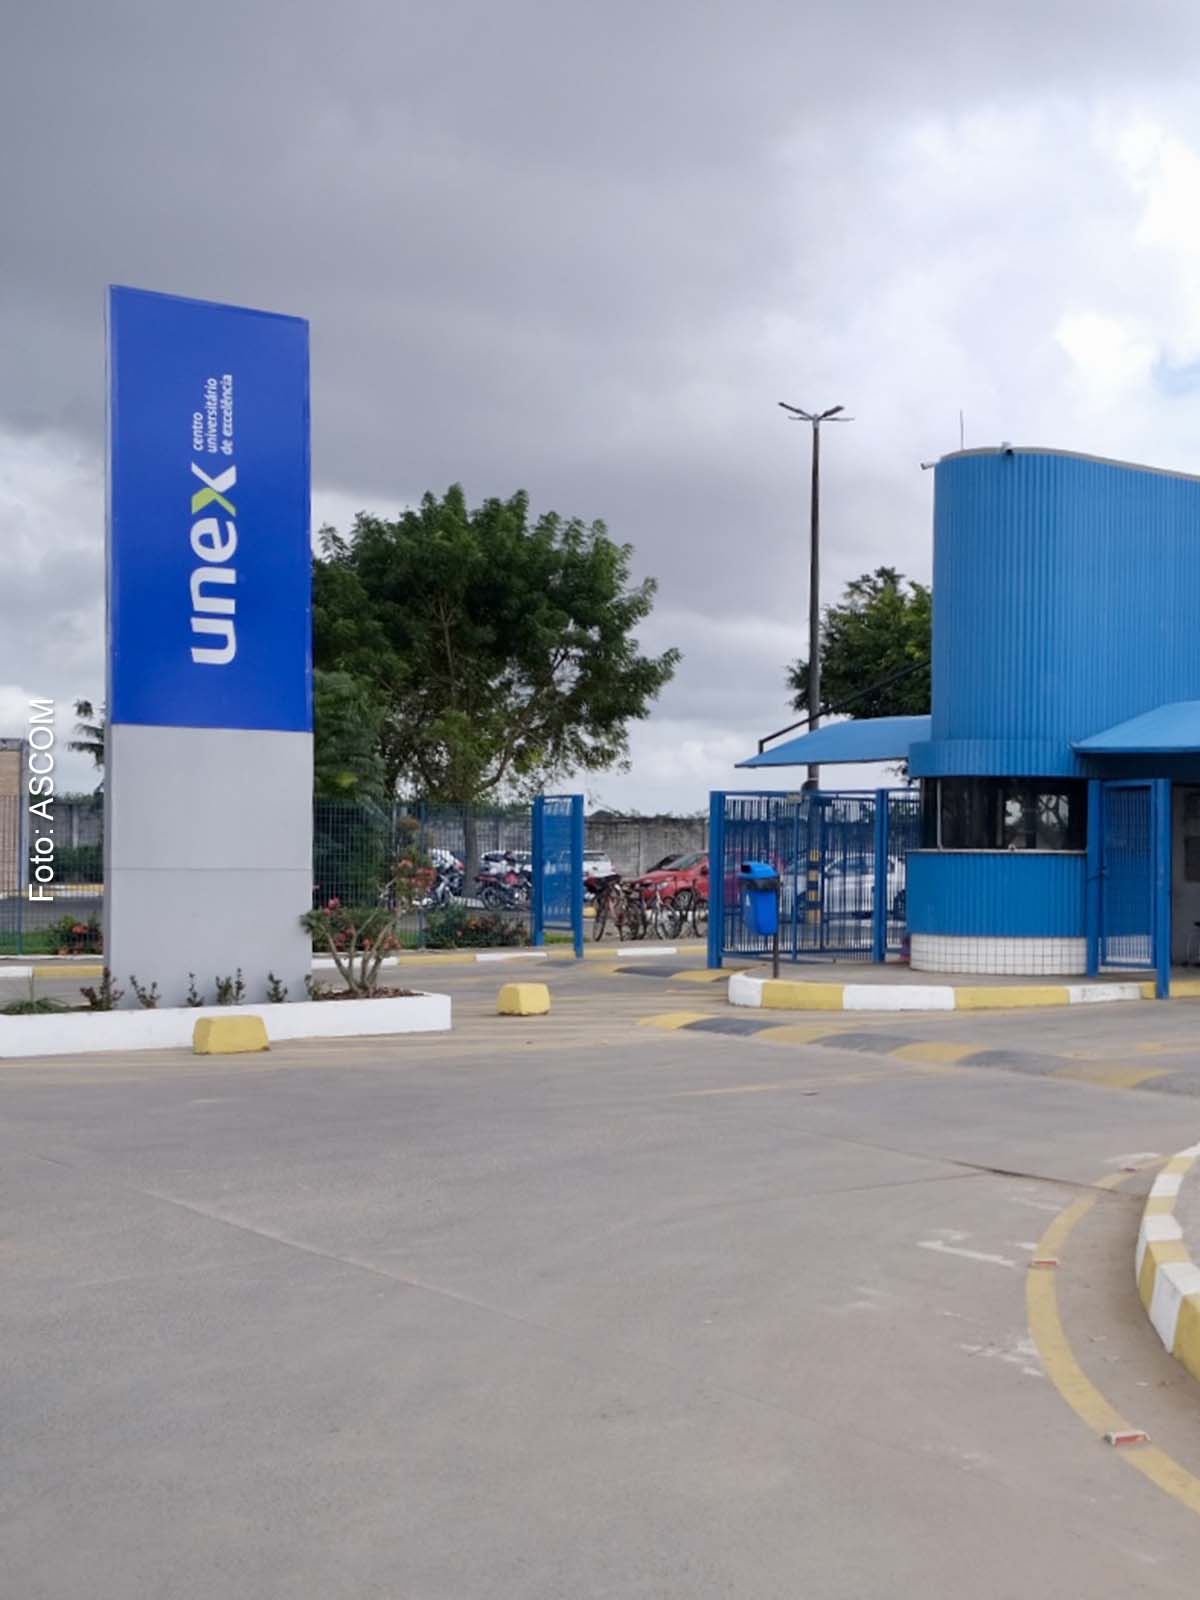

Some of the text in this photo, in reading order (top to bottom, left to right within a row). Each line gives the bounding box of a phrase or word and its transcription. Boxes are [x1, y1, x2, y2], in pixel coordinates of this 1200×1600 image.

[192, 411, 203, 451] centro
[203, 377, 217, 453] universitário
[220, 374, 233, 455] de excelência
[190, 461, 238, 665] unex
